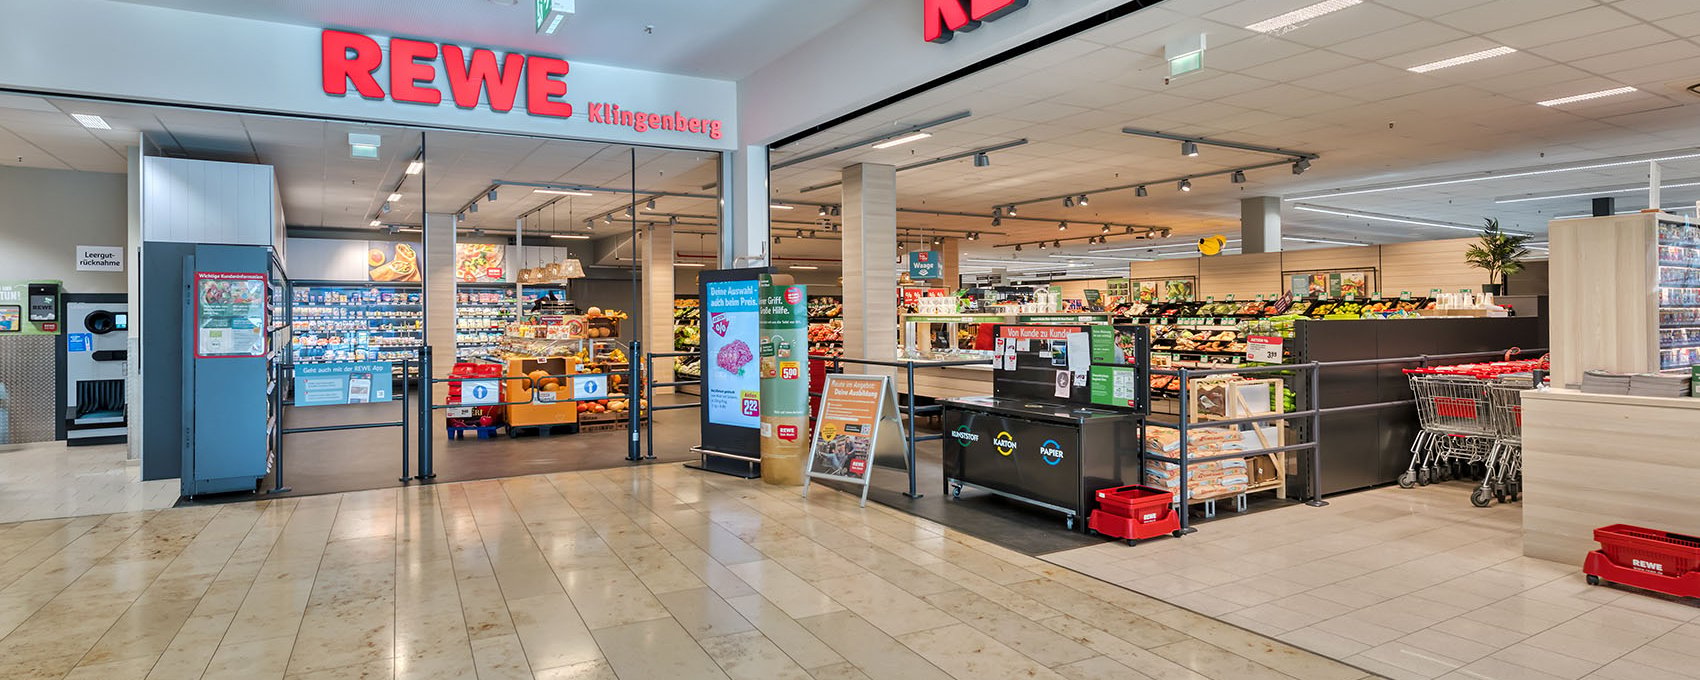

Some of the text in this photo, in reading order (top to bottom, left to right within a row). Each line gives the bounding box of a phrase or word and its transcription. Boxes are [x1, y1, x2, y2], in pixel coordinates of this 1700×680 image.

[322, 29, 572, 118] REWE
[588, 101, 723, 140] Klingenberg
[84, 251, 116, 263] Leergut-
[80, 259, 121, 267] rücknahme
[913, 262, 934, 270] Waage
[711, 287, 727, 296] Deine
[728, 286, 753, 296] Auswahl
[711, 297, 758, 307] auch beim Preis.
[768, 296, 783, 305] Griff.
[773, 306, 790, 315] Hilfe.
[1008, 328, 1019, 337] Von
[1021, 329, 1038, 337] Kunde
[372, 364, 383, 372] App
[835, 388, 878, 400] Deine Ausbildung
[744, 400, 758, 415] 2.22
[952, 430, 979, 442] KUNSTSTOFF
[994, 438, 1017, 449] KARTON
[1040, 447, 1064, 459] PAPIER
[1632, 559, 1663, 571] REWE
